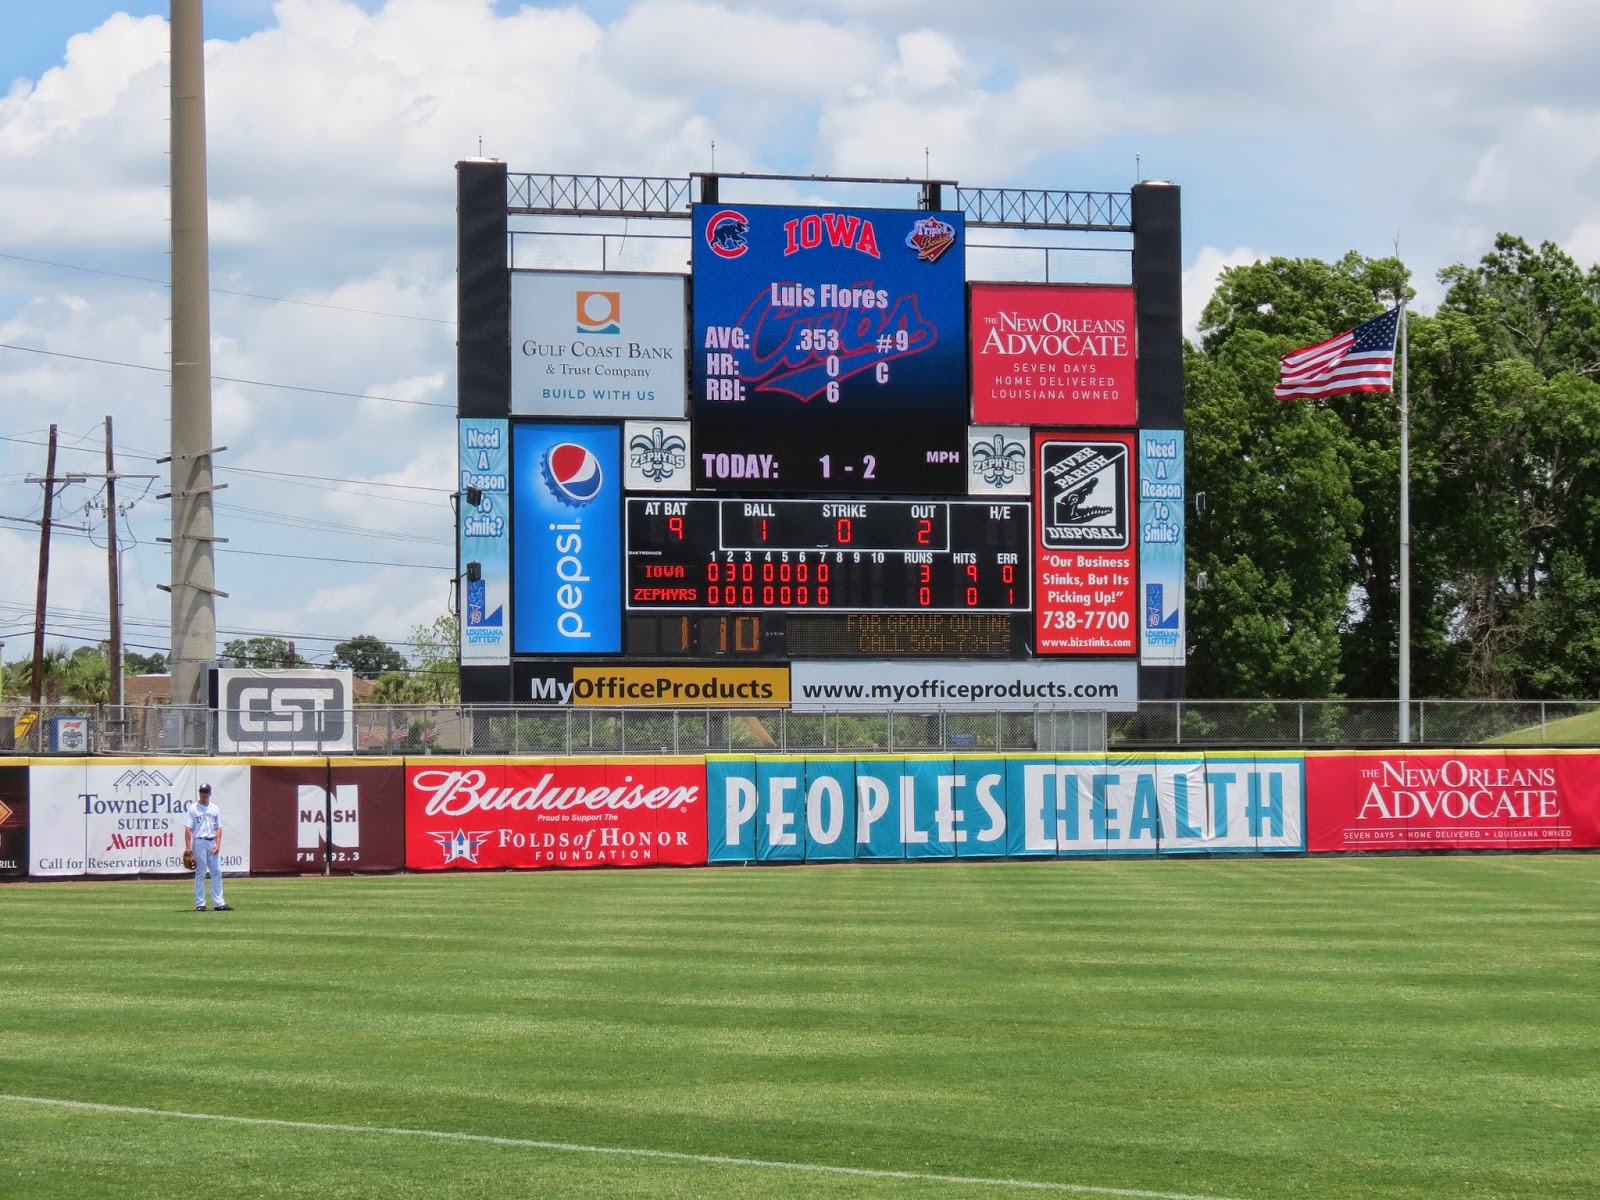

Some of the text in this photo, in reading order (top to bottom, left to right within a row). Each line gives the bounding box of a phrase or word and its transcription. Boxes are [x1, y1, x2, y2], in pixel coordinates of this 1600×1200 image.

[784, 213, 881, 259] IOWA
[771, 283, 888, 308] Luis Flores
[705, 326, 909, 353] AVG: .353 #9
[980, 327, 1128, 357] ADVOCATE
[522, 340, 674, 359] GULF COAST BANK
[545, 364, 651, 379] & Trust Company
[707, 353, 888, 384] HR: 0 C
[1013, 363, 1096, 373] SEVEN DAYS
[995, 376, 1115, 386] HOME DELIVERED
[543, 389, 655, 401] BUILD WITH US
[706, 379, 839, 403] RBI: 6
[991, 390, 1119, 400] LOUISIANA OWNED
[467, 428, 500, 449] Need
[926, 451, 960, 463] MPH
[1145, 439, 1176, 459] Need
[478, 450, 490, 471] A
[631, 451, 686, 469] ZEPHYRS
[703, 454, 779, 478] TODAY:
[820, 455, 830, 478] 1
[863, 454, 876, 479] 2
[973, 458, 1025, 475] ZEPHYRS
[1049, 447, 1098, 477] RIVER
[1054, 455, 1110, 489] PARISH
[1156, 460, 1167, 480] A
[461, 470, 506, 492] Reason
[1141, 479, 1182, 500] Reason
[645, 502, 688, 516] AT BAT
[744, 504, 775, 517] BALL
[822, 504, 867, 518] STRIKE
[911, 505, 936, 519] OUT
[990, 506, 1011, 520] H/E
[1154, 501, 1170, 520] To
[464, 516, 504, 538] Smile?
[669, 517, 683, 540] 9
[761, 519, 767, 540] 1
[838, 519, 851, 543] 0
[918, 520, 932, 544] 2
[1046, 527, 1123, 540] DISPOSAL
[1144, 523, 1179, 544] Smile?
[710, 551, 885, 563] 1 2 3 4 5 6 7 8 9 10
[904, 553, 1018, 564] RUNS HITS ERR
[1077, 555, 1130, 568] Business
[550, 523, 591, 638] pepsi
[645, 563, 1013, 583] IOWA 0 3 0 0 0 0 0 3 9 0
[1042, 573, 1129, 587] Stinks, But Its
[634, 588, 697, 601] ZEPHYRS
[708, 586, 719, 604] 0
[725, 586, 736, 604] 0
[742, 586, 753, 604] 0
[763, 586, 774, 604] 0
[780, 586, 791, 604] 0
[797, 586, 808, 604] 0
[818, 586, 829, 604] 0
[920, 587, 930, 605] 0
[967, 587, 977, 605] 0
[1048, 591, 1091, 606] Picking
[1043, 611, 1130, 629] 738-7700
[466, 628, 503, 636] LOUISIANA
[1042, 636, 1131, 647] www.bizstinks.com
[1146, 630, 1180, 638] LOUISIANA
[531, 677, 773, 705] MyOfficeProducts
[802, 679, 1119, 702] www.myofficeproducts.com
[239, 687, 334, 732] CST
[1361, 769, 1380, 778] THE
[413, 770, 699, 817] Budweiser
[1355, 781, 1561, 819] ADVOCATE
[78, 793, 191, 814] TownePlac
[725, 774, 1007, 845] PEOPLES
[1040, 772, 1283, 841] HEALTH
[117, 818, 169, 830] SUITES
[300, 810, 356, 823] NASH
[537, 814, 560, 822] Proud
[571, 814, 603, 823] Support
[604, 813, 618, 821] The
[106, 832, 175, 852] Marriott
[498, 828, 689, 850] FOLDS of HONOR
[1374, 831, 1395, 839] DAYS
[1493, 830, 1539, 838] LOUISIANA
[1542, 829, 1572, 837] OWNED
[39, 858, 63, 869] Call
[66, 857, 84, 869] for
[88, 856, 162, 868] Reservations
[296, 853, 314, 862] FM
[535, 850, 652, 861] FOUNDATION
